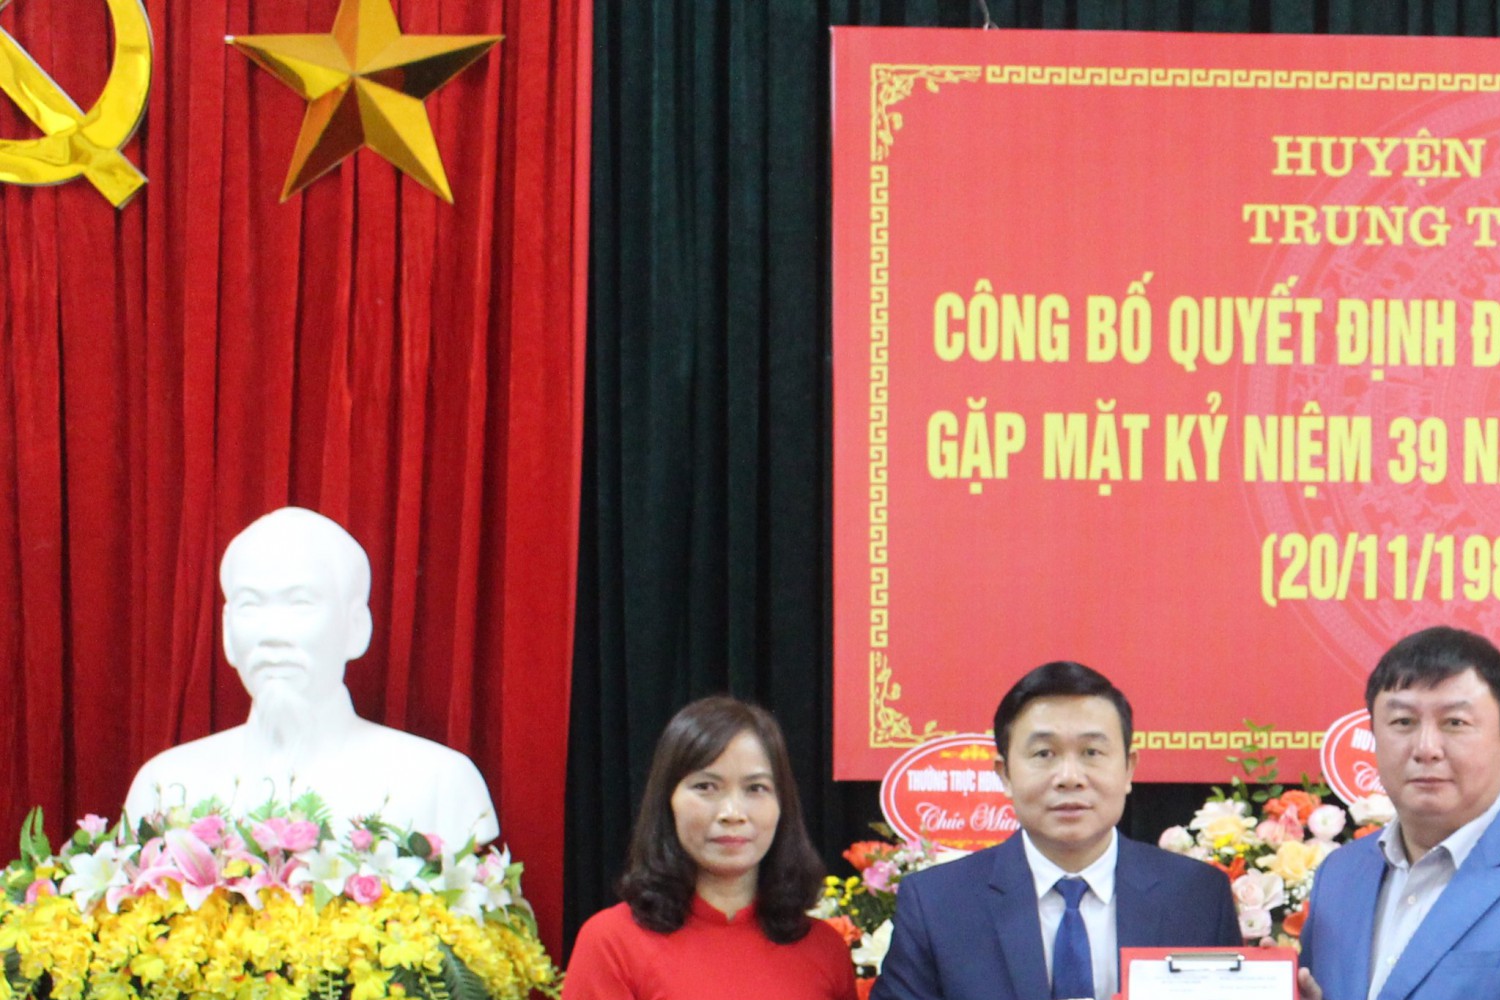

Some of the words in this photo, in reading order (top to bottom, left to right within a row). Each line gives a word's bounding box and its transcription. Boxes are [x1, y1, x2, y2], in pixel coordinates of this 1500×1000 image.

[1271, 129, 1486, 185] HUYỆN
[1243, 203, 1451, 247] TRUNG
[933, 279, 1070, 363] CÔNG
[1087, 271, 1154, 364] BỐ
[1169, 275, 1322, 373] QUYẾT
[1336, 298, 1457, 381] ĐỊNH
[926, 397, 1027, 495] GẶP
[1043, 399, 1150, 497] MẶT
[1165, 391, 1229, 482] KỶ
[1244, 401, 1373, 499] NIỆM
[1388, 417, 1449, 485] 39
[916, 802, 965, 832] Chúc
